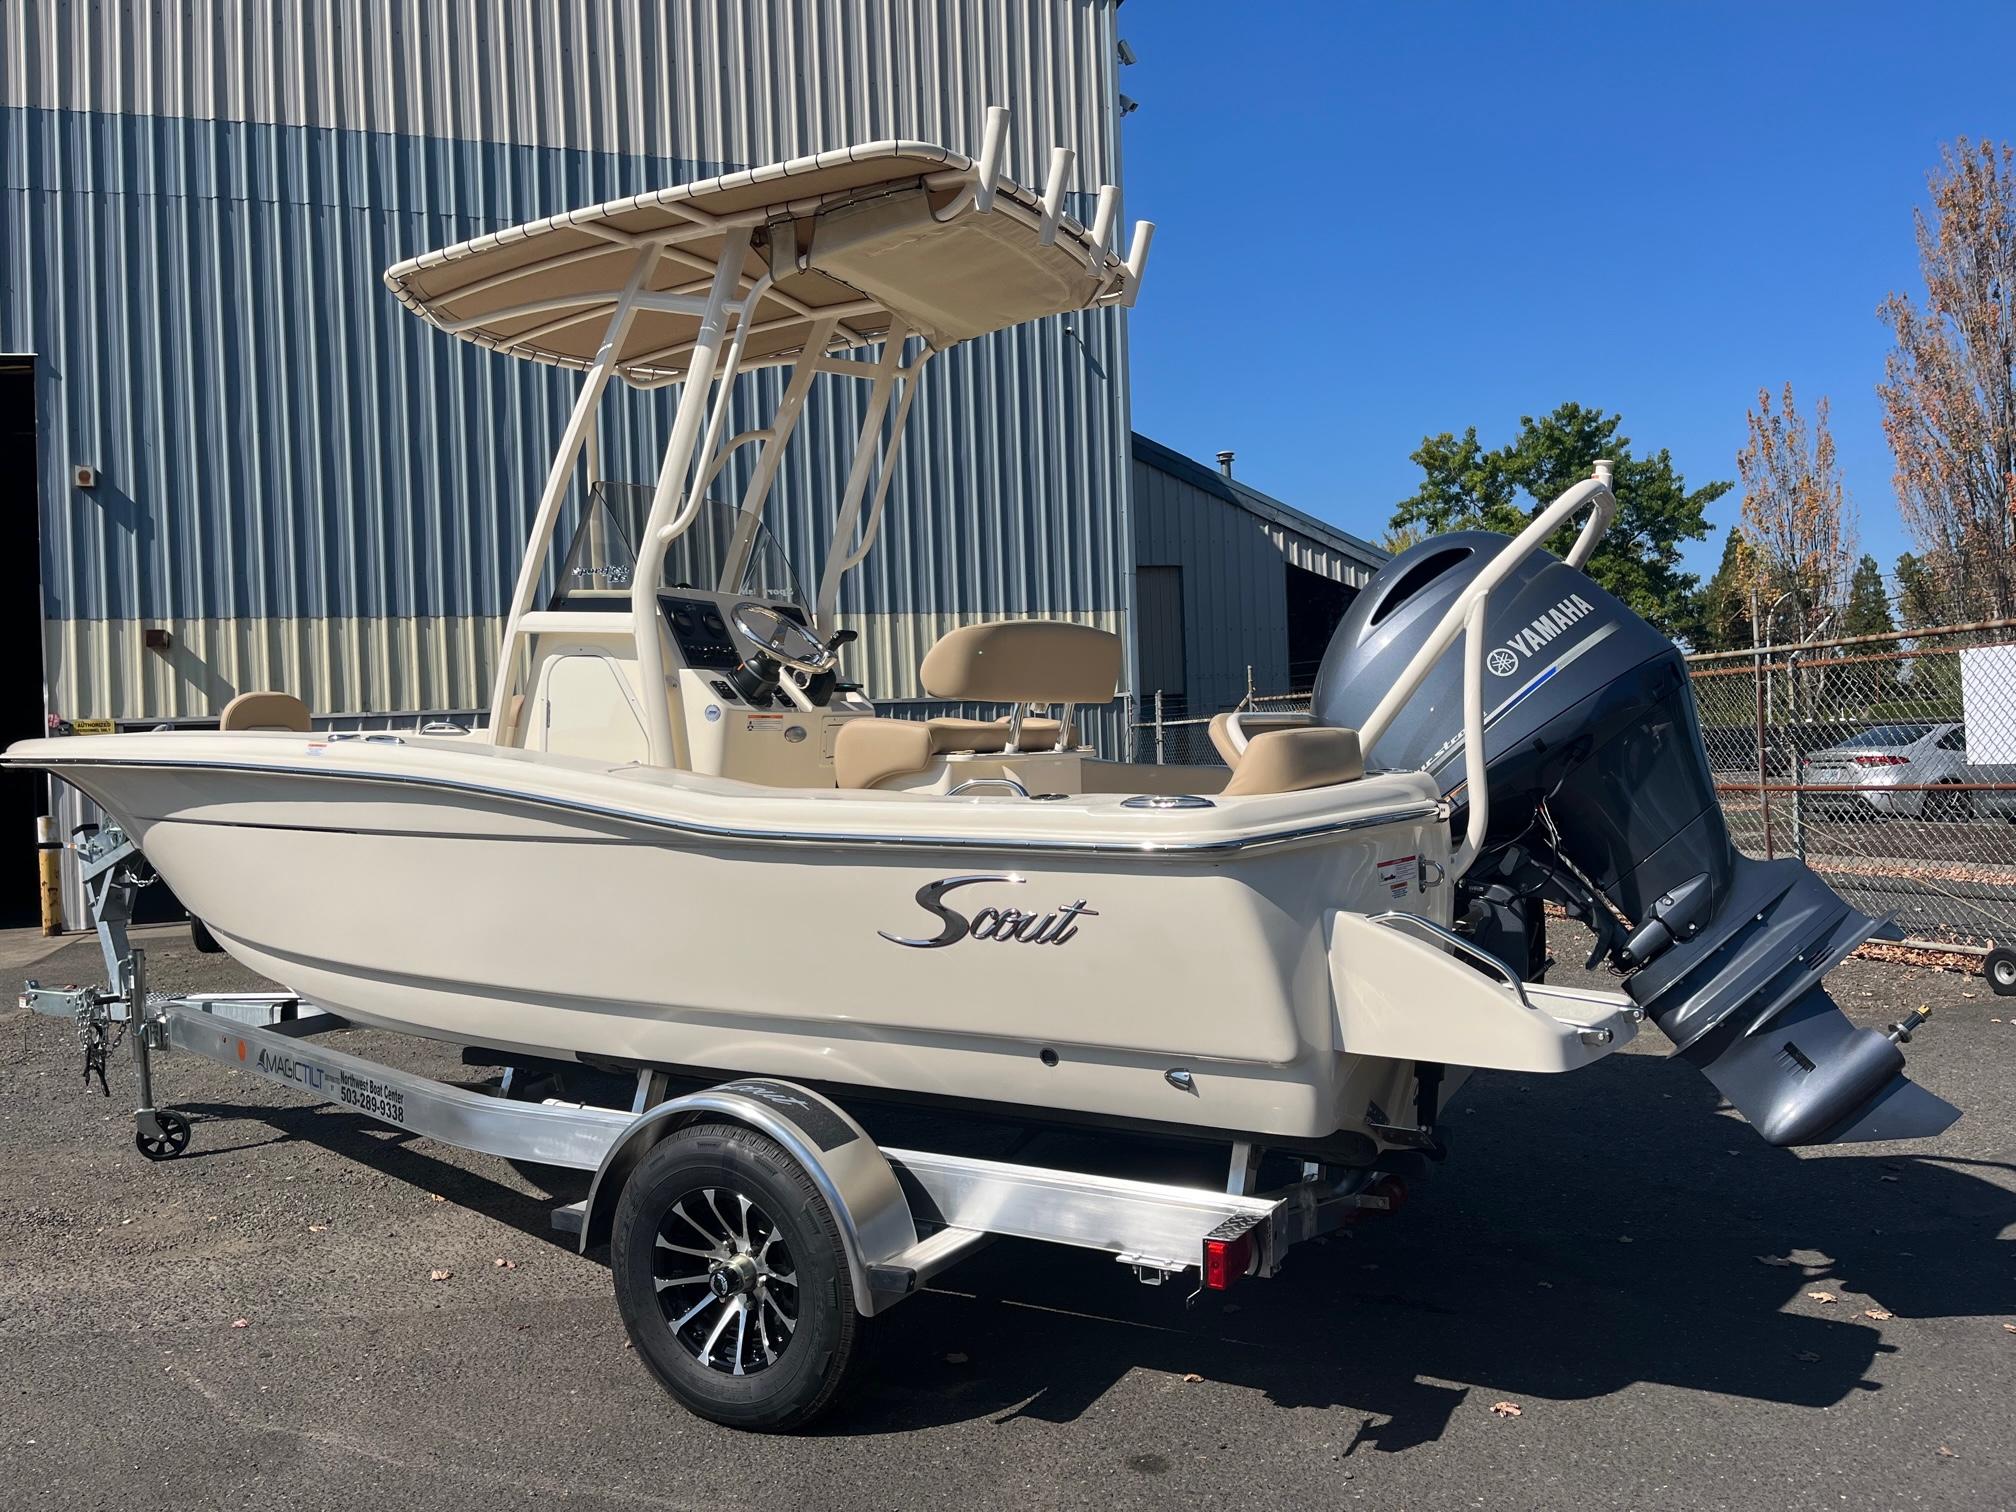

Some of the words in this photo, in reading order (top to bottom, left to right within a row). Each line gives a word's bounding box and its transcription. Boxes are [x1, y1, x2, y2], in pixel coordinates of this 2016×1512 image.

[1506, 593, 1595, 658] YAMAHA
[877, 874, 1099, 948] Scout
[266, 1052, 325, 1090] MAGICTILT
[340, 1070, 368, 1093] Northwest
[369, 1080, 383, 1098] Boat
[384, 1085, 404, 1105] Center
[341, 1086, 404, 1123] 503-289-9338
